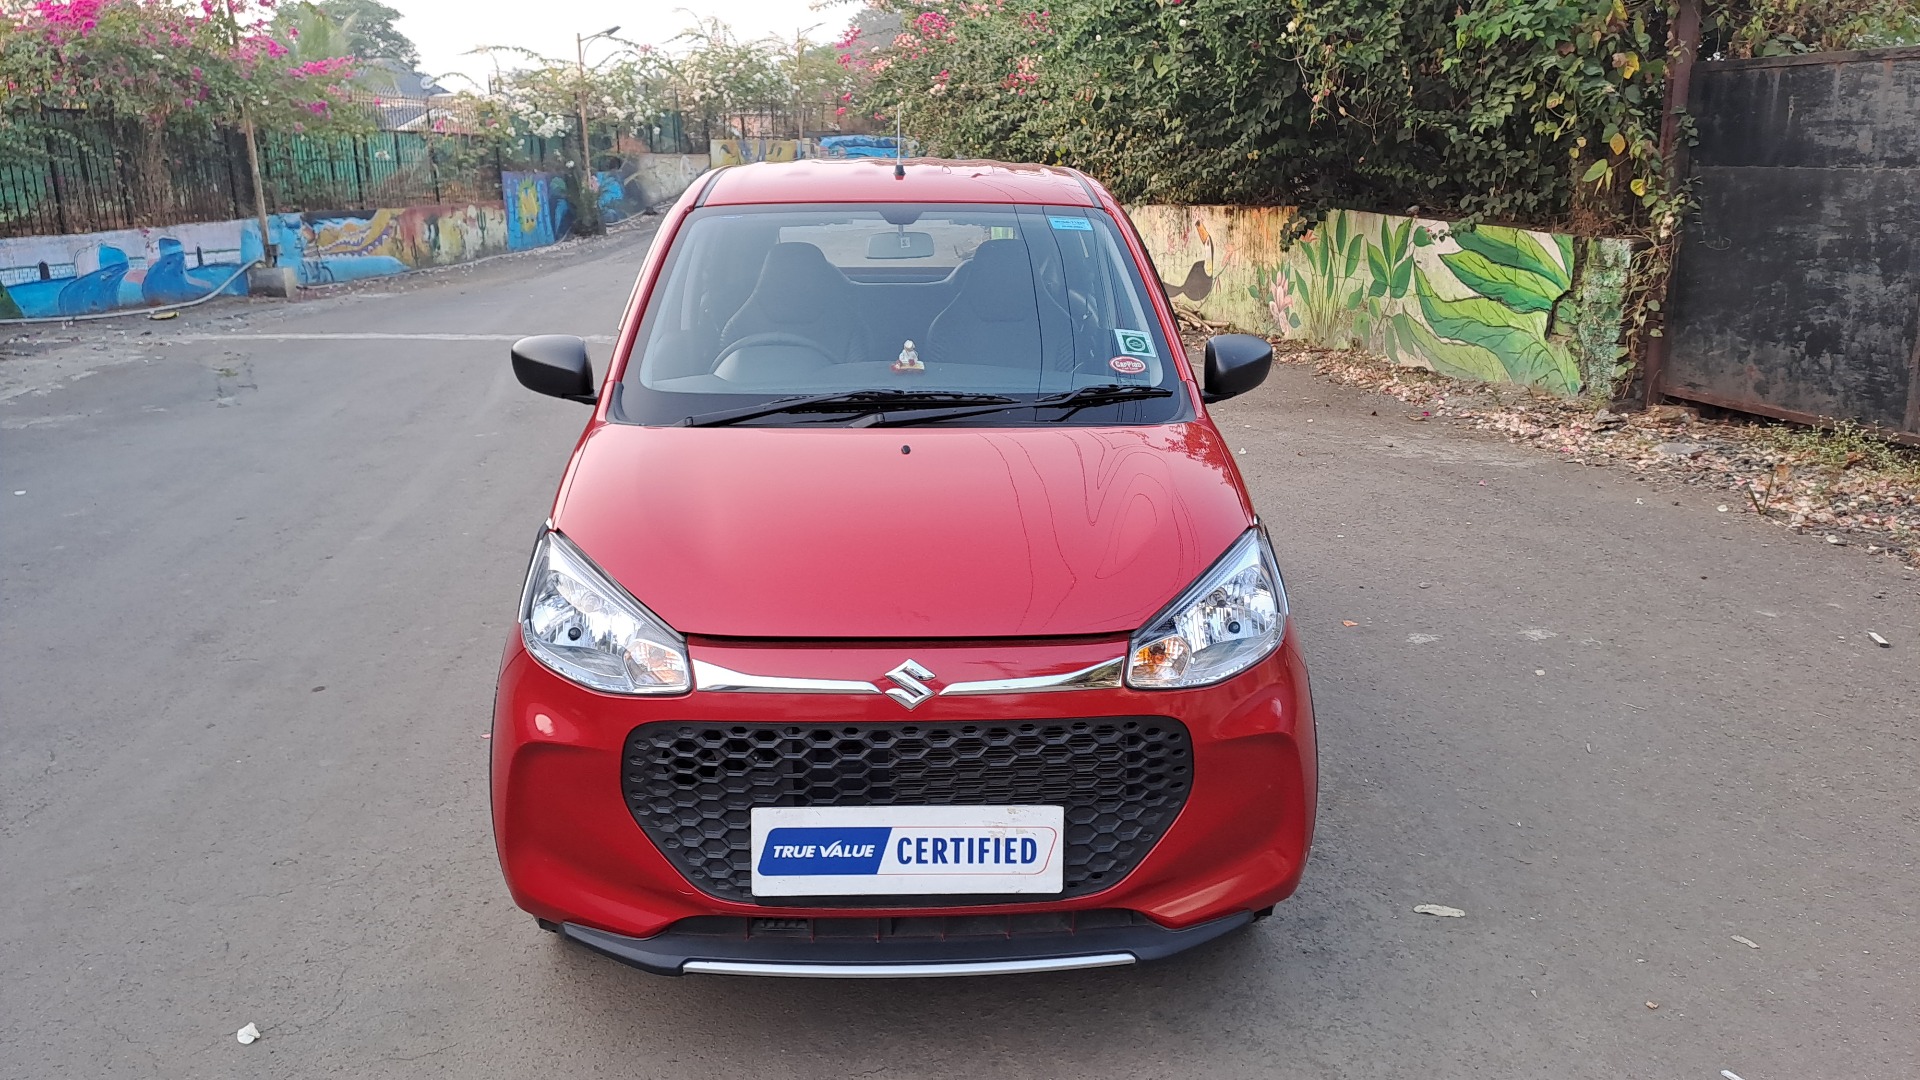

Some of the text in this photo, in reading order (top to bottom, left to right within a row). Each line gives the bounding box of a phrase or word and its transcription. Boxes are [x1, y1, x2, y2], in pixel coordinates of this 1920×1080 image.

[773, 837, 1037, 865] TRUE VALUE CERTIFIED
